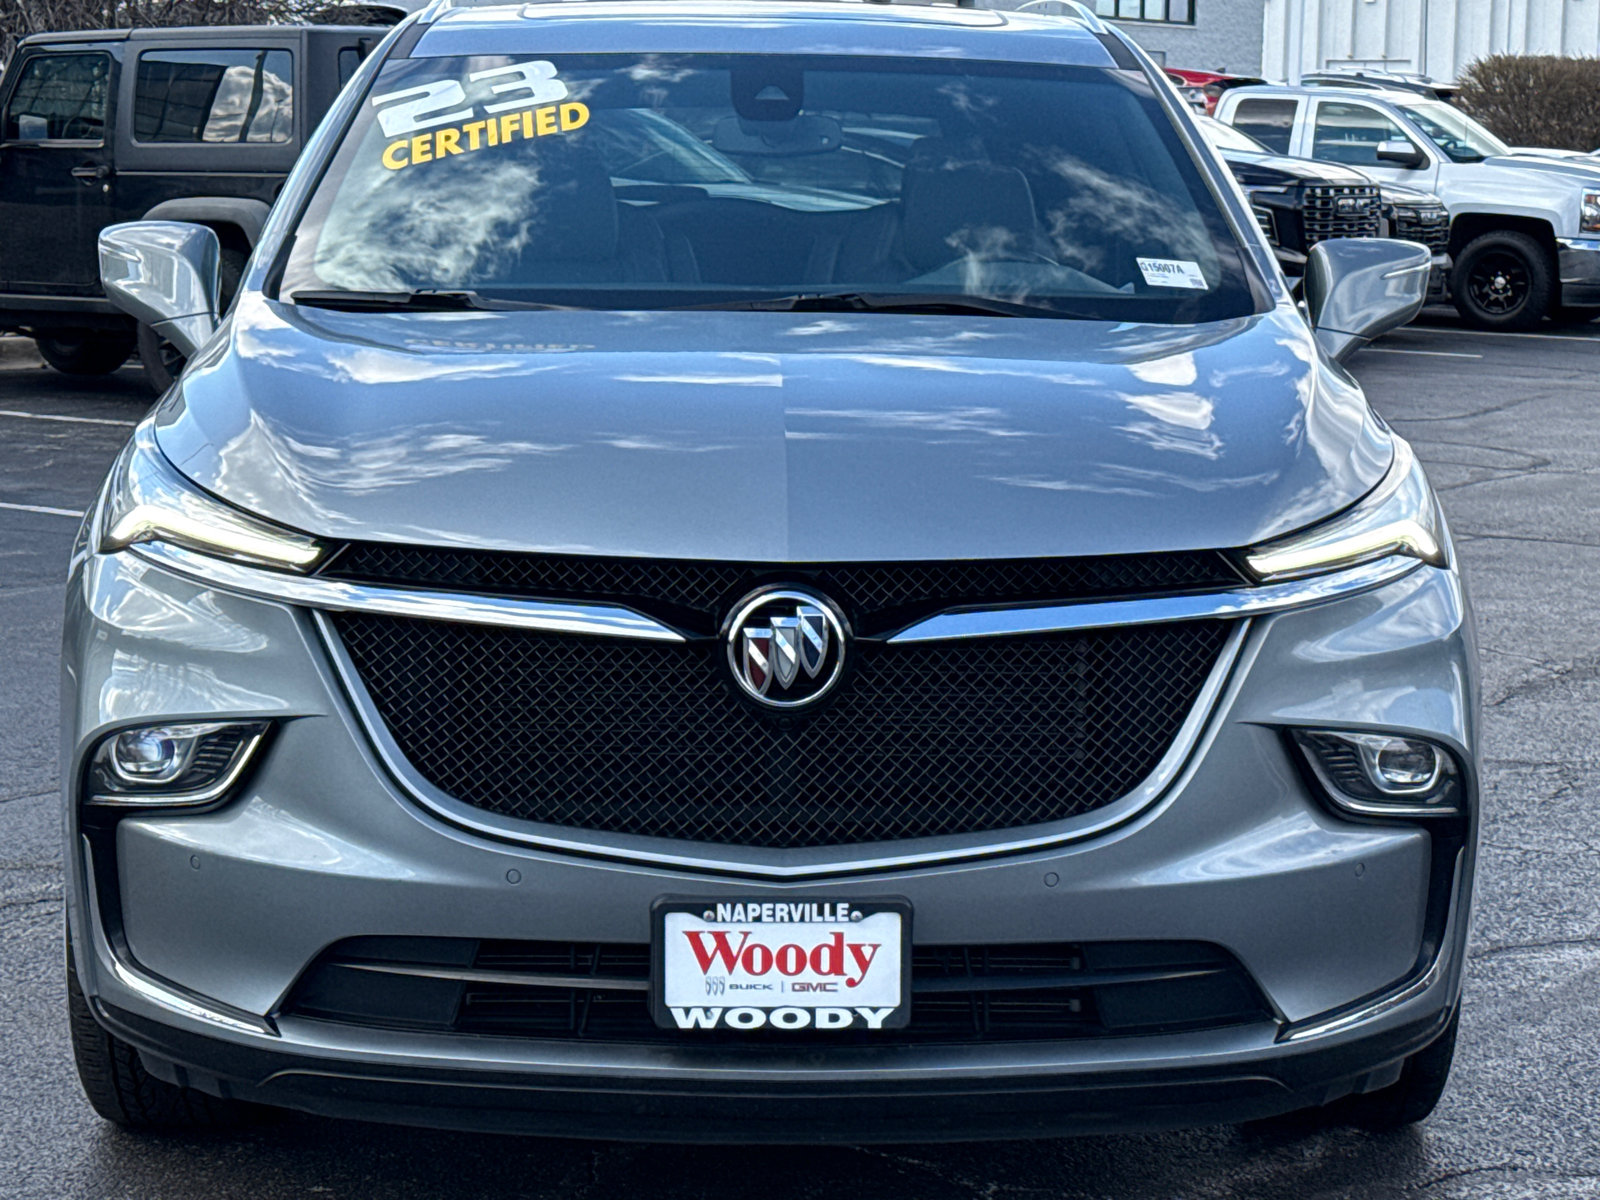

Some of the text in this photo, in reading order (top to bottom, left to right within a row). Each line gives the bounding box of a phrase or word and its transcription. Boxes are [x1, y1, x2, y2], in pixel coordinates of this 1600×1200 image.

[371, 60, 569, 138] 23
[381, 102, 590, 170] CERTIFIED
[716, 902, 850, 923] NAPERVILLE
[682, 930, 882, 988] Woody
[729, 981, 838, 993] BUICK GMC
[669, 1007, 896, 1030] WOODY
